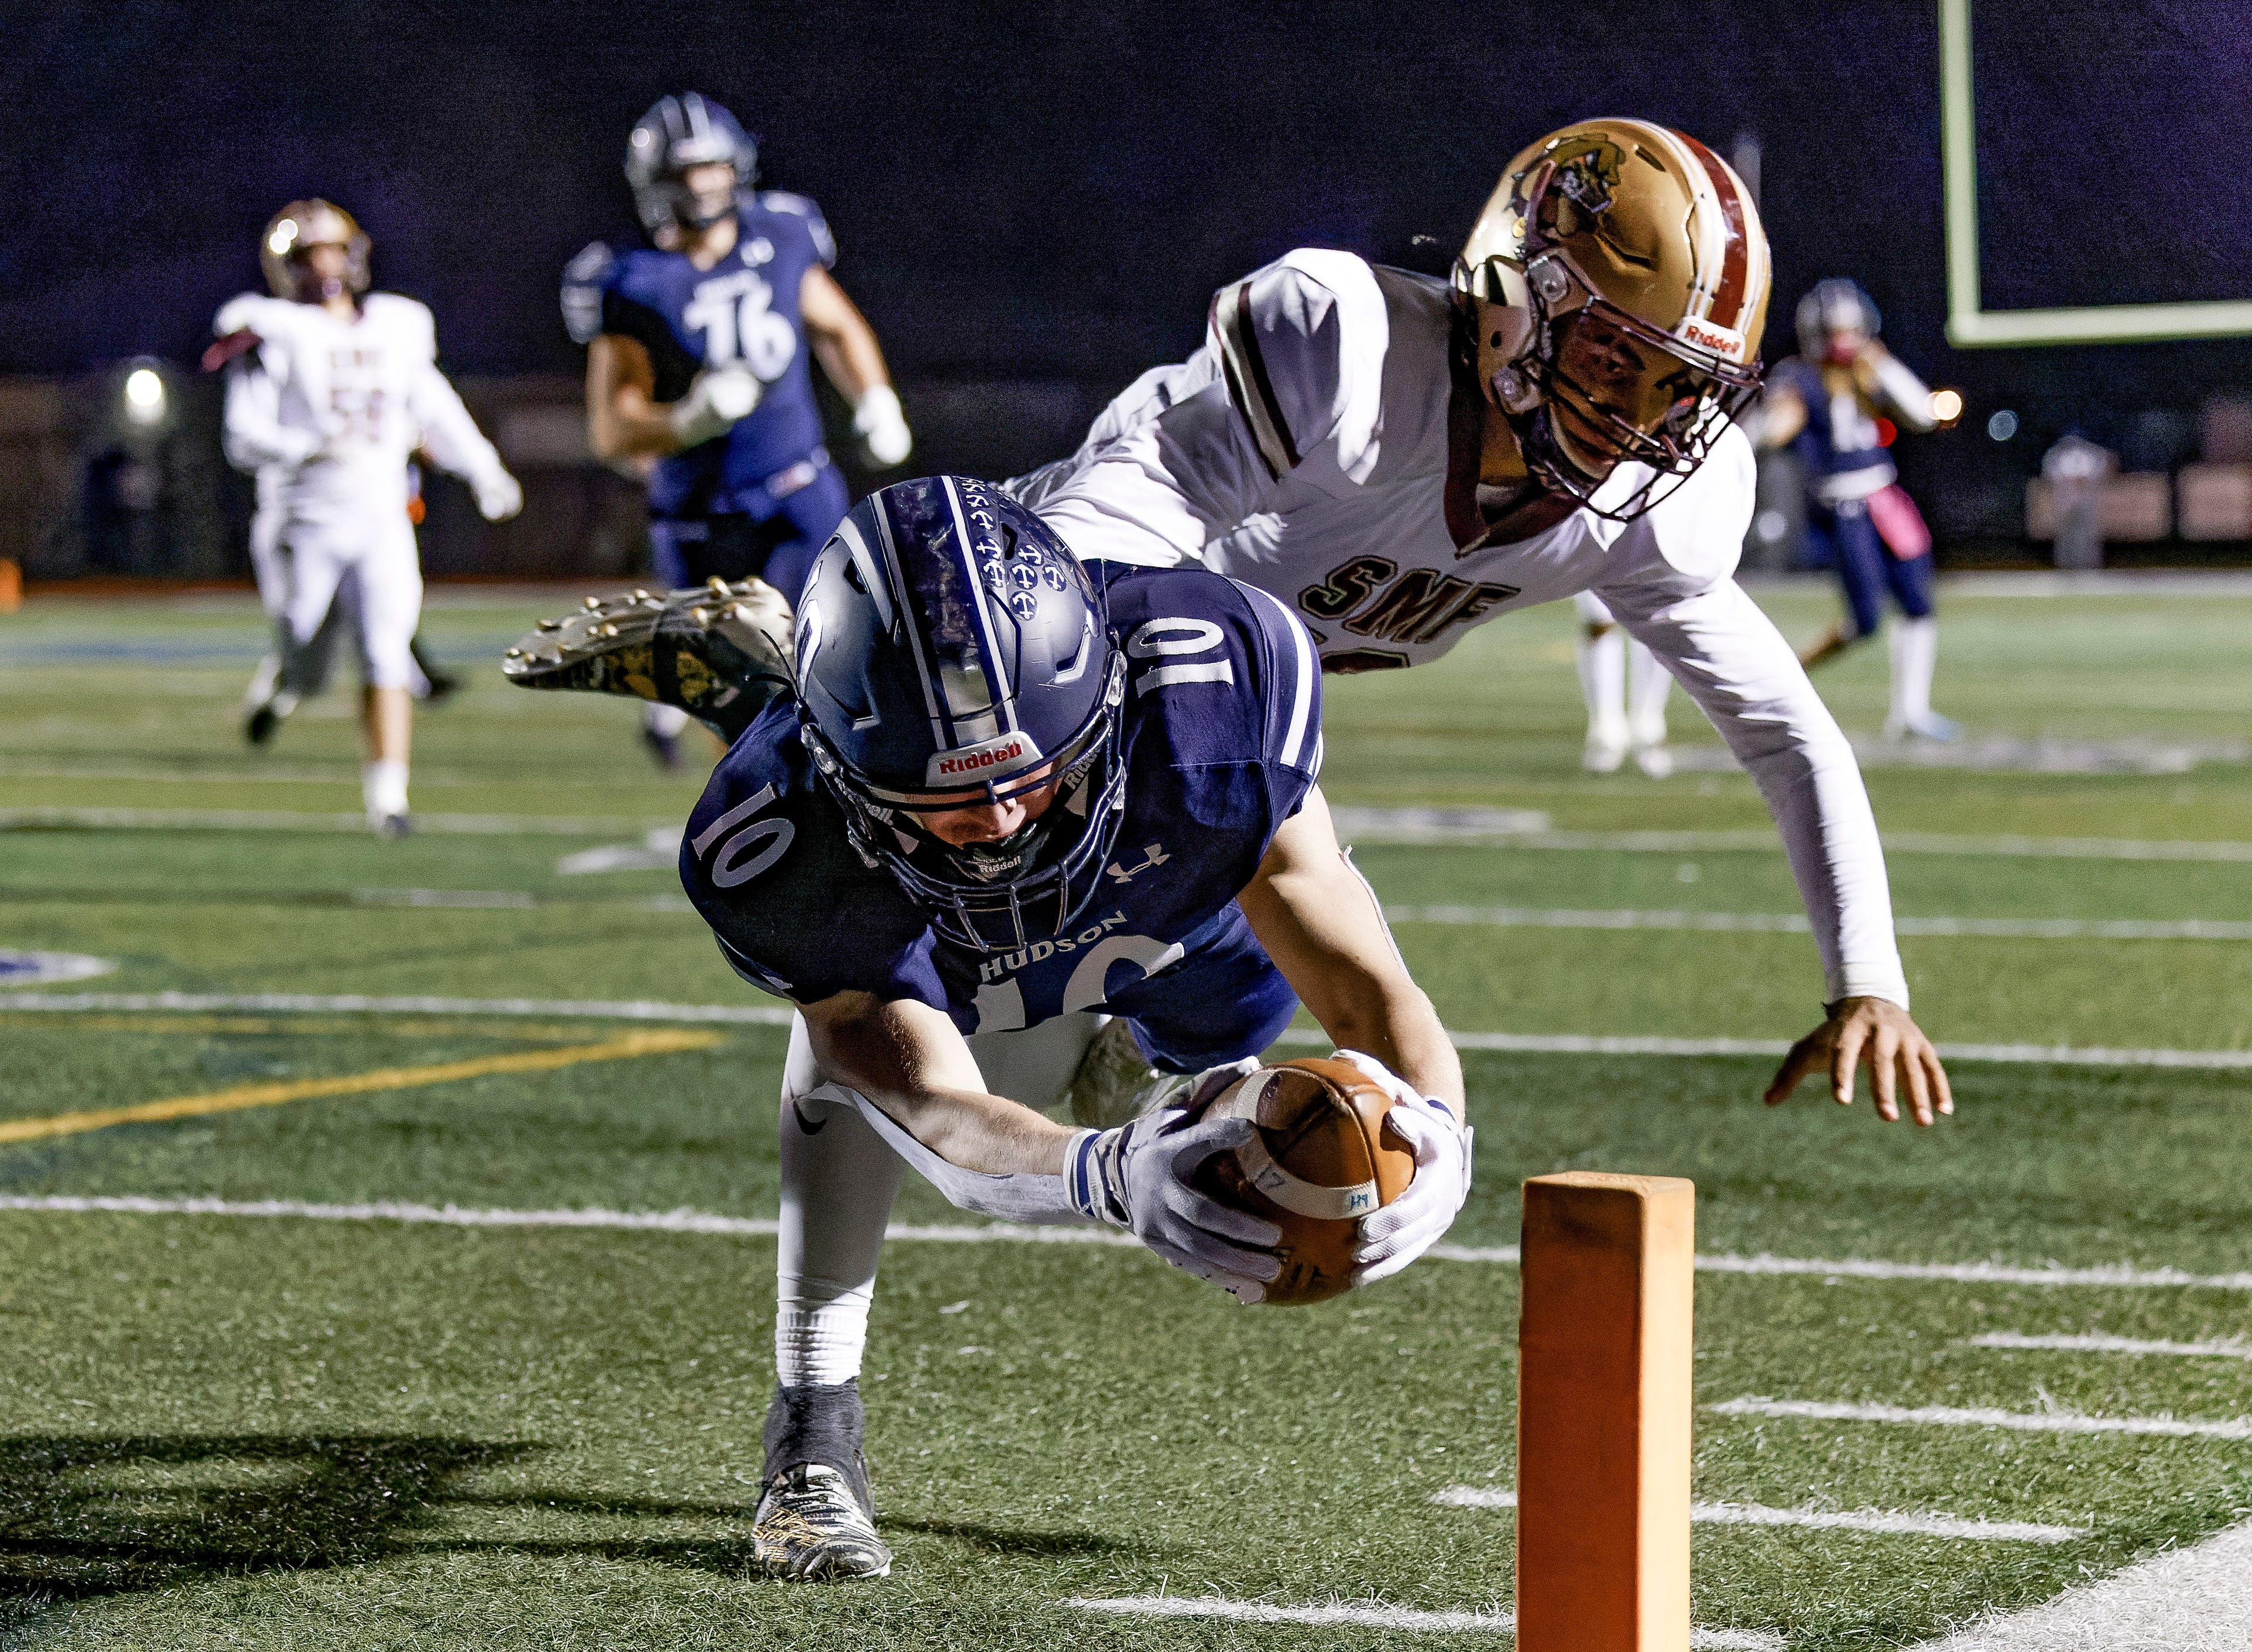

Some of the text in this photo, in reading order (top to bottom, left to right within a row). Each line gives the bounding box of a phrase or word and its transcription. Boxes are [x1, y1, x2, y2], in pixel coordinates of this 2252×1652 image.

[1685, 325, 1741, 354] Riddell
[1298, 555, 1522, 643] SMF
[1127, 616, 1234, 699] 10
[939, 739, 1023, 775] Riddell
[691, 781, 795, 888] 10
[978, 855, 1021, 873] Riddell
[978, 910, 1128, 982] HUDSON
